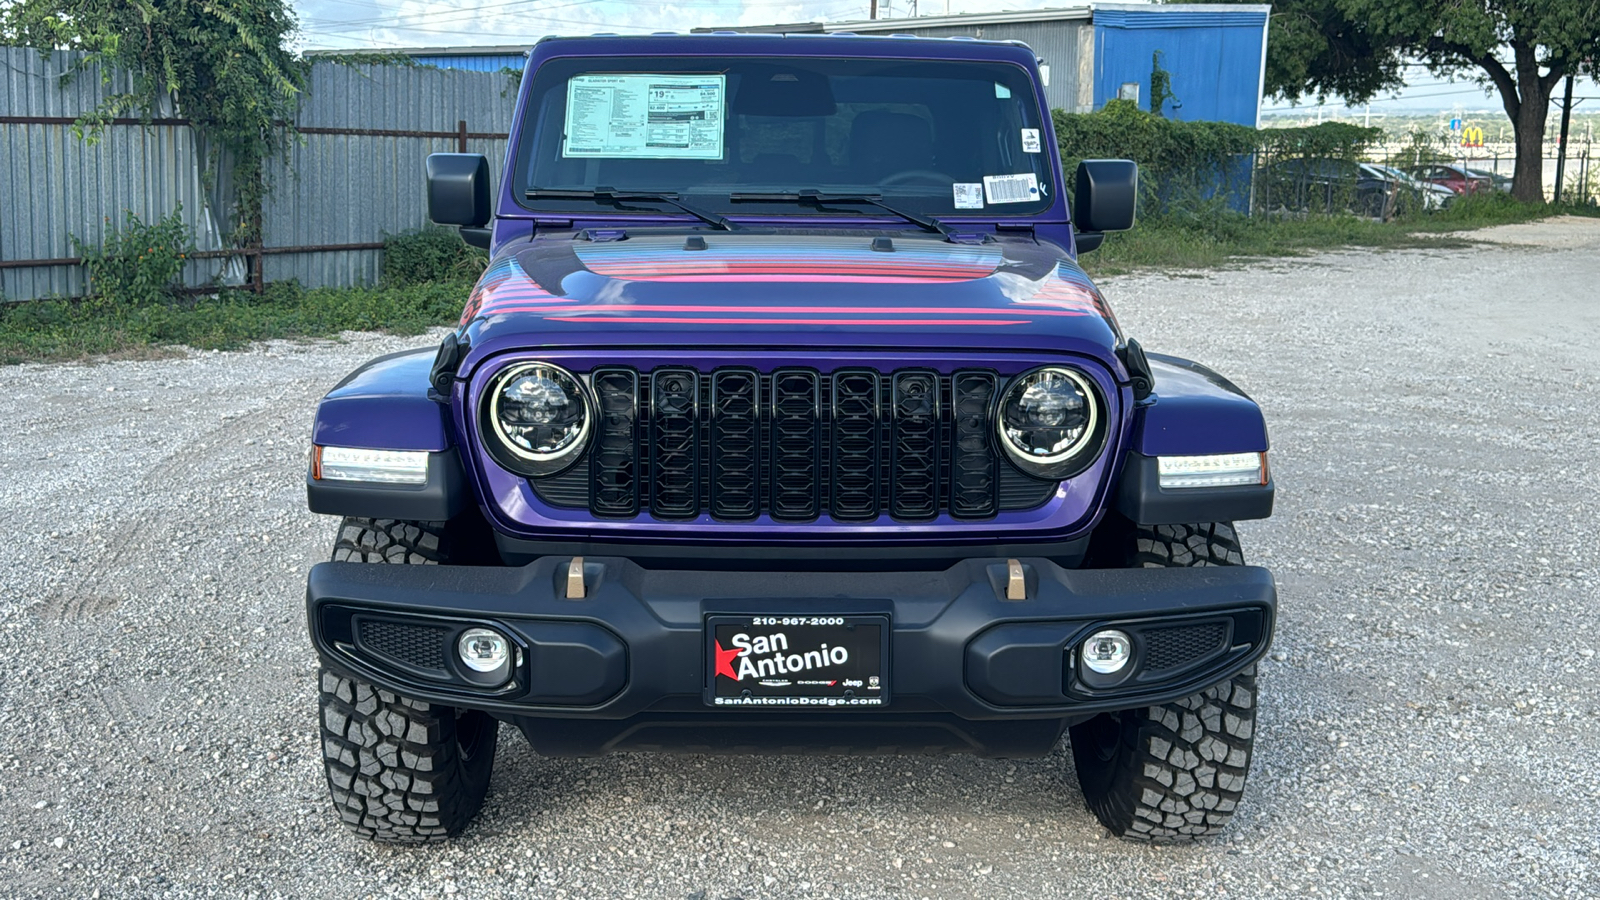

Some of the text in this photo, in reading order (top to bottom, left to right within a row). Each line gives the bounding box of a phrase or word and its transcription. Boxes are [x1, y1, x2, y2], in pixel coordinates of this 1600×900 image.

[654, 90, 664, 98] 19
[752, 617, 844, 626] 210-967-2000
[731, 632, 788, 657] San
[737, 643, 848, 681] Antonio
[842, 678, 863, 688] Jeep
[714, 697, 882, 706] SanAntonioDodge.com
